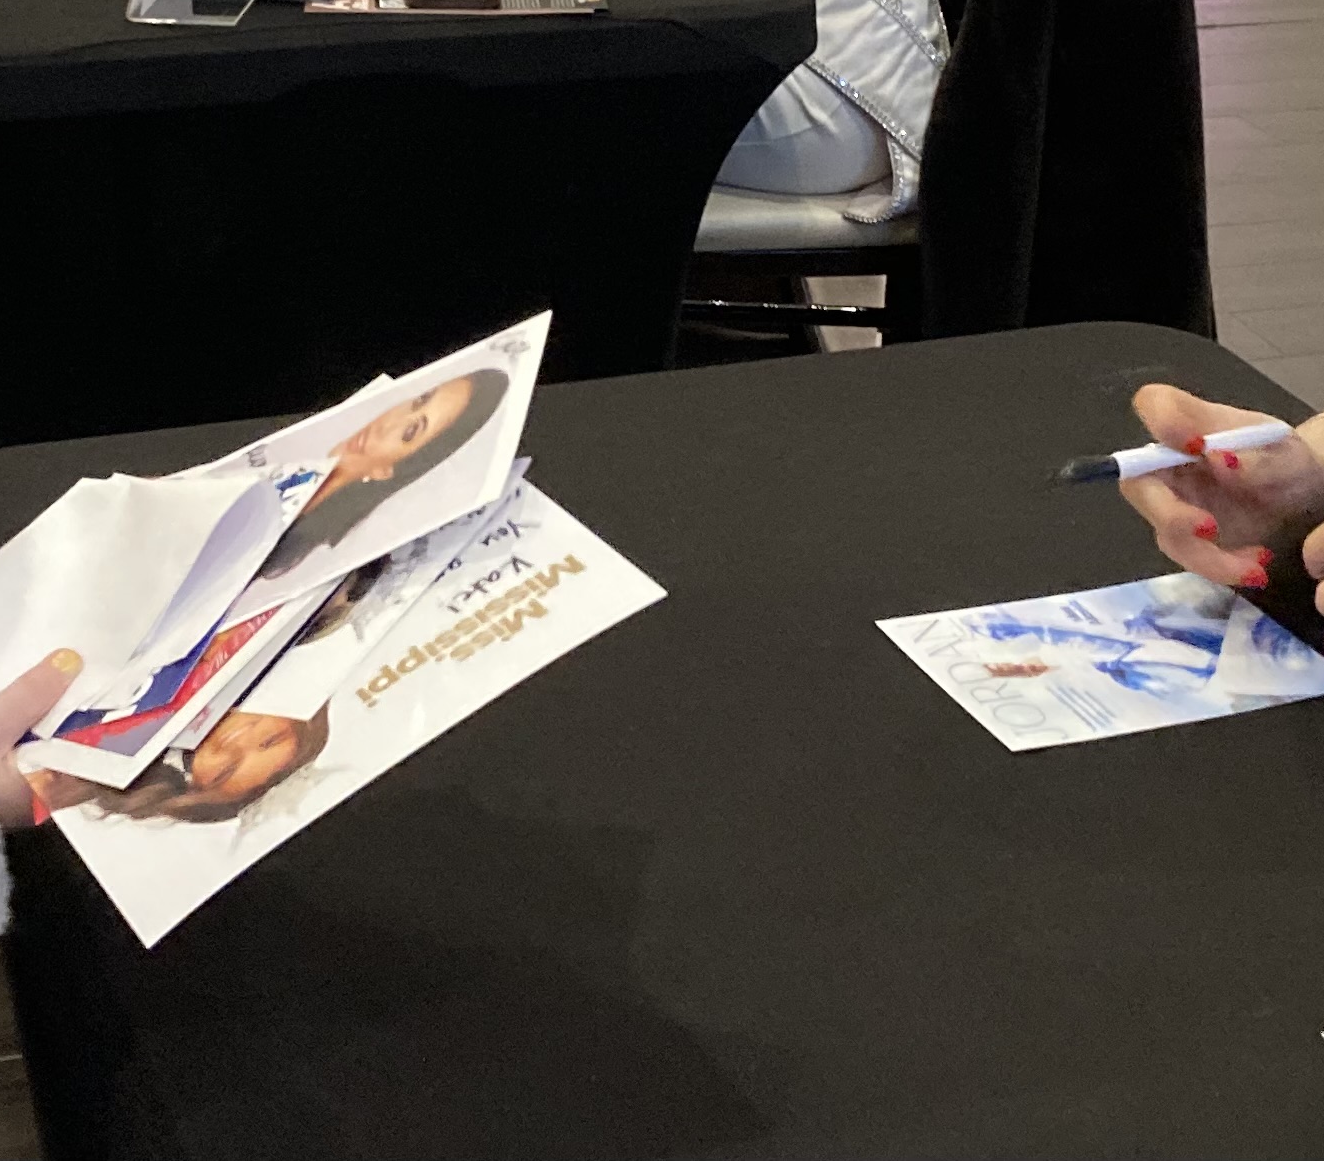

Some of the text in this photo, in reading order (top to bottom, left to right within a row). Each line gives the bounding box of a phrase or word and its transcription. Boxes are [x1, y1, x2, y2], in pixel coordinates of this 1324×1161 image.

[355, 553, 587, 709] Mississippi
[450, 598, 550, 663] Miss
[898, 618, 1069, 740] JORDAN
